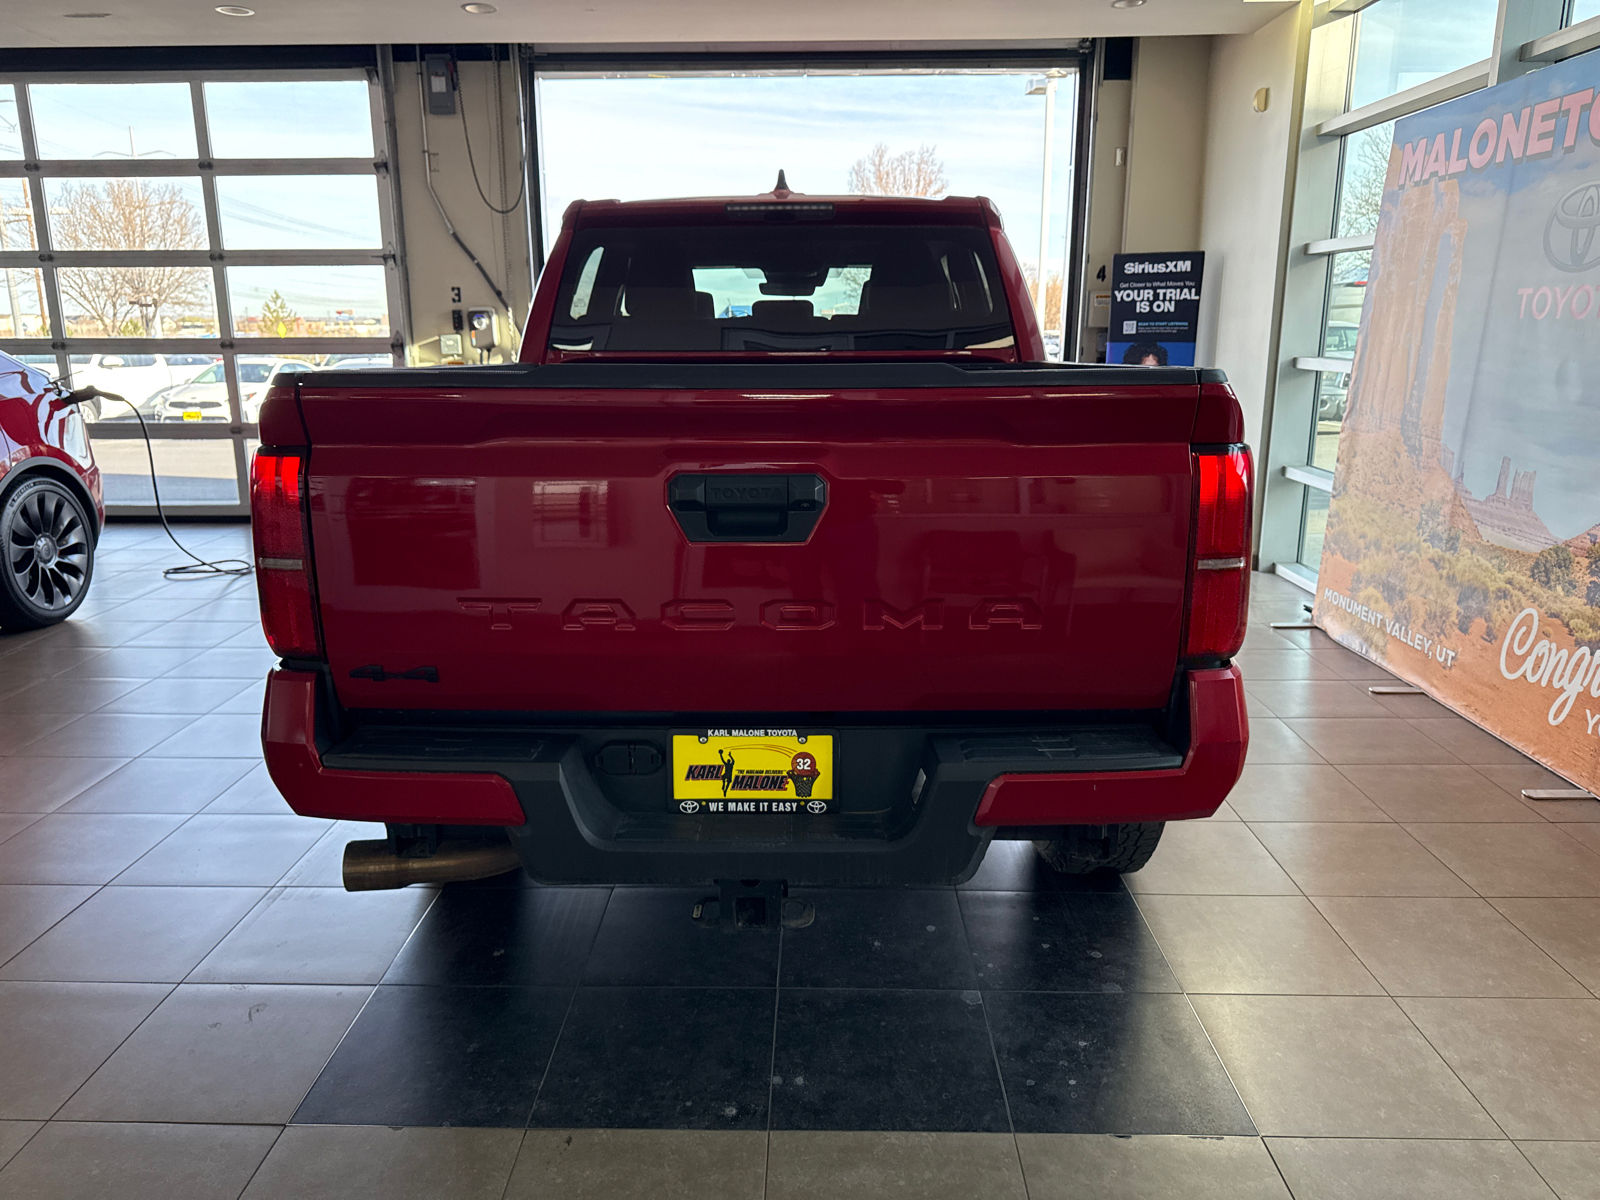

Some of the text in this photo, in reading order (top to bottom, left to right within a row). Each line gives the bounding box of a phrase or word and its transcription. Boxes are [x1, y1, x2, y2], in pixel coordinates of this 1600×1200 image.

[1096, 265, 1106, 282] 4
[1124, 260, 1191, 274] SiriusXM
[451, 286, 462, 303] 3
[1114, 289, 1154, 302] YOUR
[1157, 288, 1199, 300] TRIAL
[1517, 284, 1600, 320] TOYO
[1136, 301, 1175, 313] IS ON
[709, 487, 784, 501] TOYOTA
[456, 597, 1043, 631] TACOMA
[1323, 587, 1456, 667] MONUMENT VALLEY, UT
[707, 729, 798, 737] KARL MALONE TOYOTA
[796, 758, 811, 770] 32
[685, 764, 724, 781] KARL
[730, 775, 789, 791] MALONE
[709, 802, 797, 812] WE MAKE IT EASY
